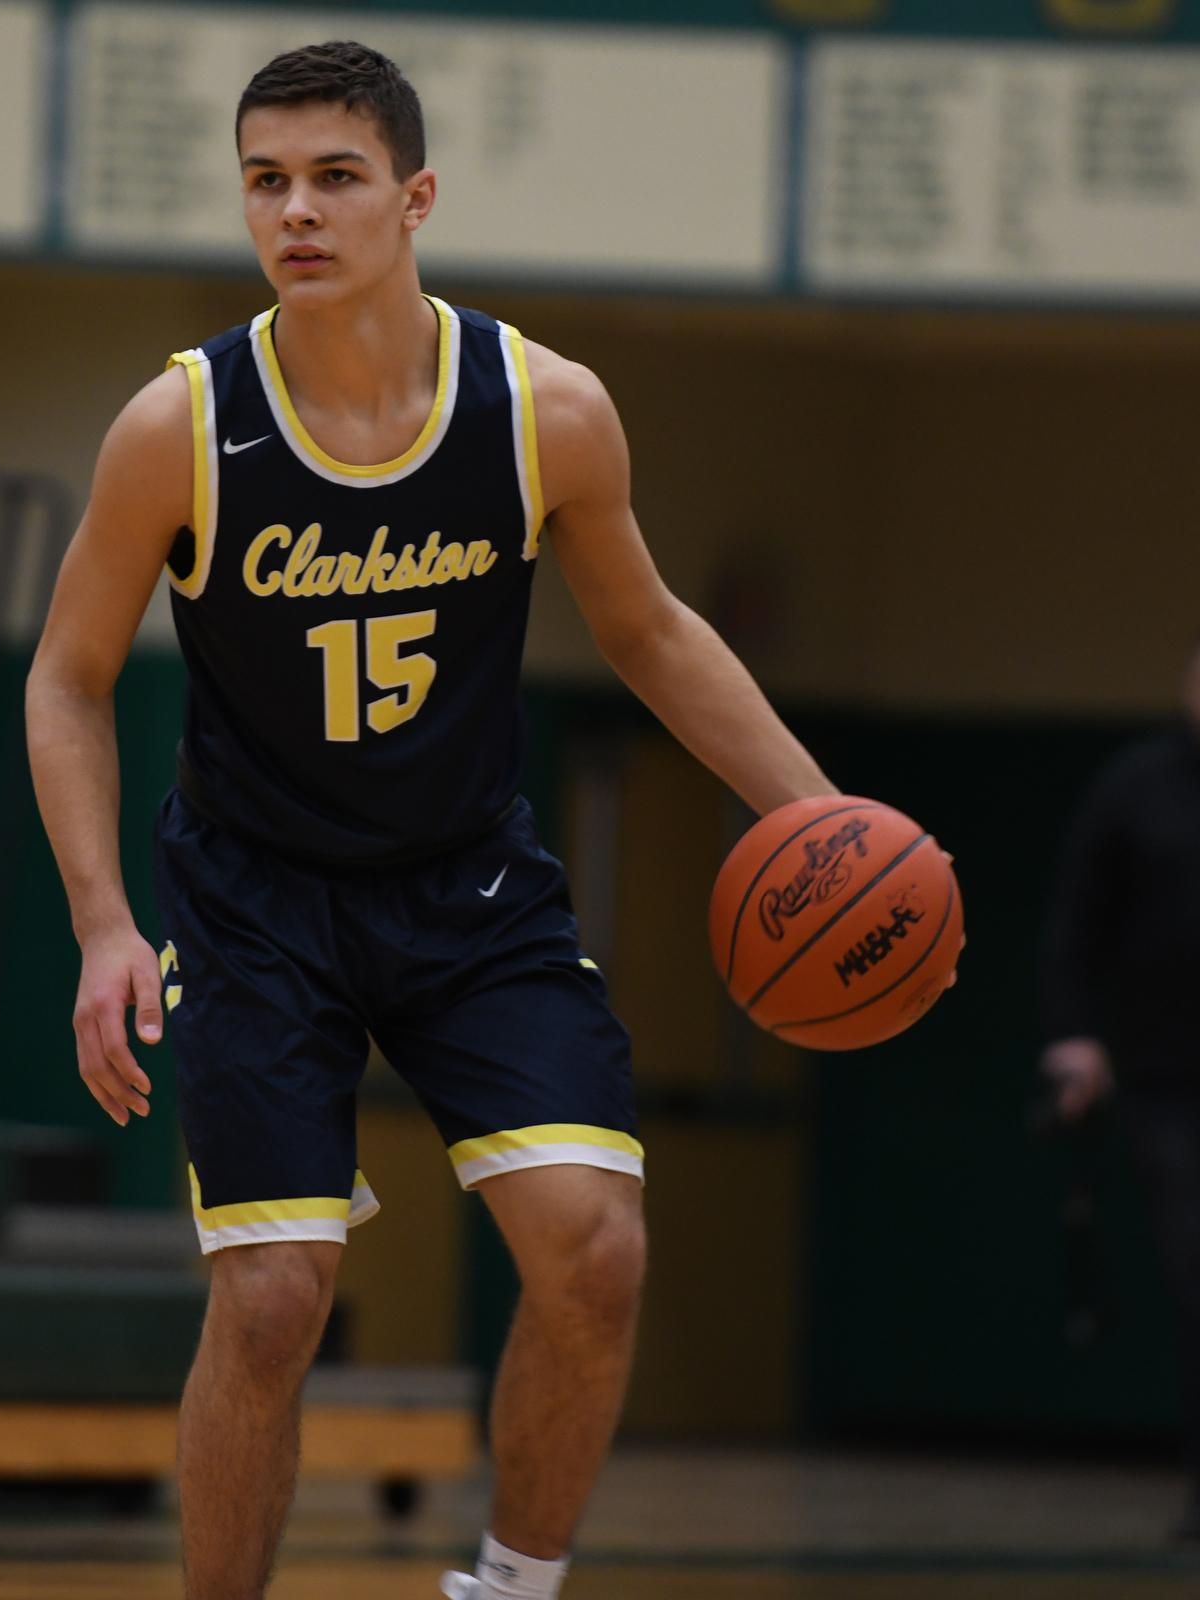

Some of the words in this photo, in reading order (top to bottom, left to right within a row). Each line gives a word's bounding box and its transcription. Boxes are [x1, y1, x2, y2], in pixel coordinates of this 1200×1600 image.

[242, 522, 498, 597] Clarkston
[306, 608, 437, 742] 15
[759, 818, 871, 942] Rawlings
